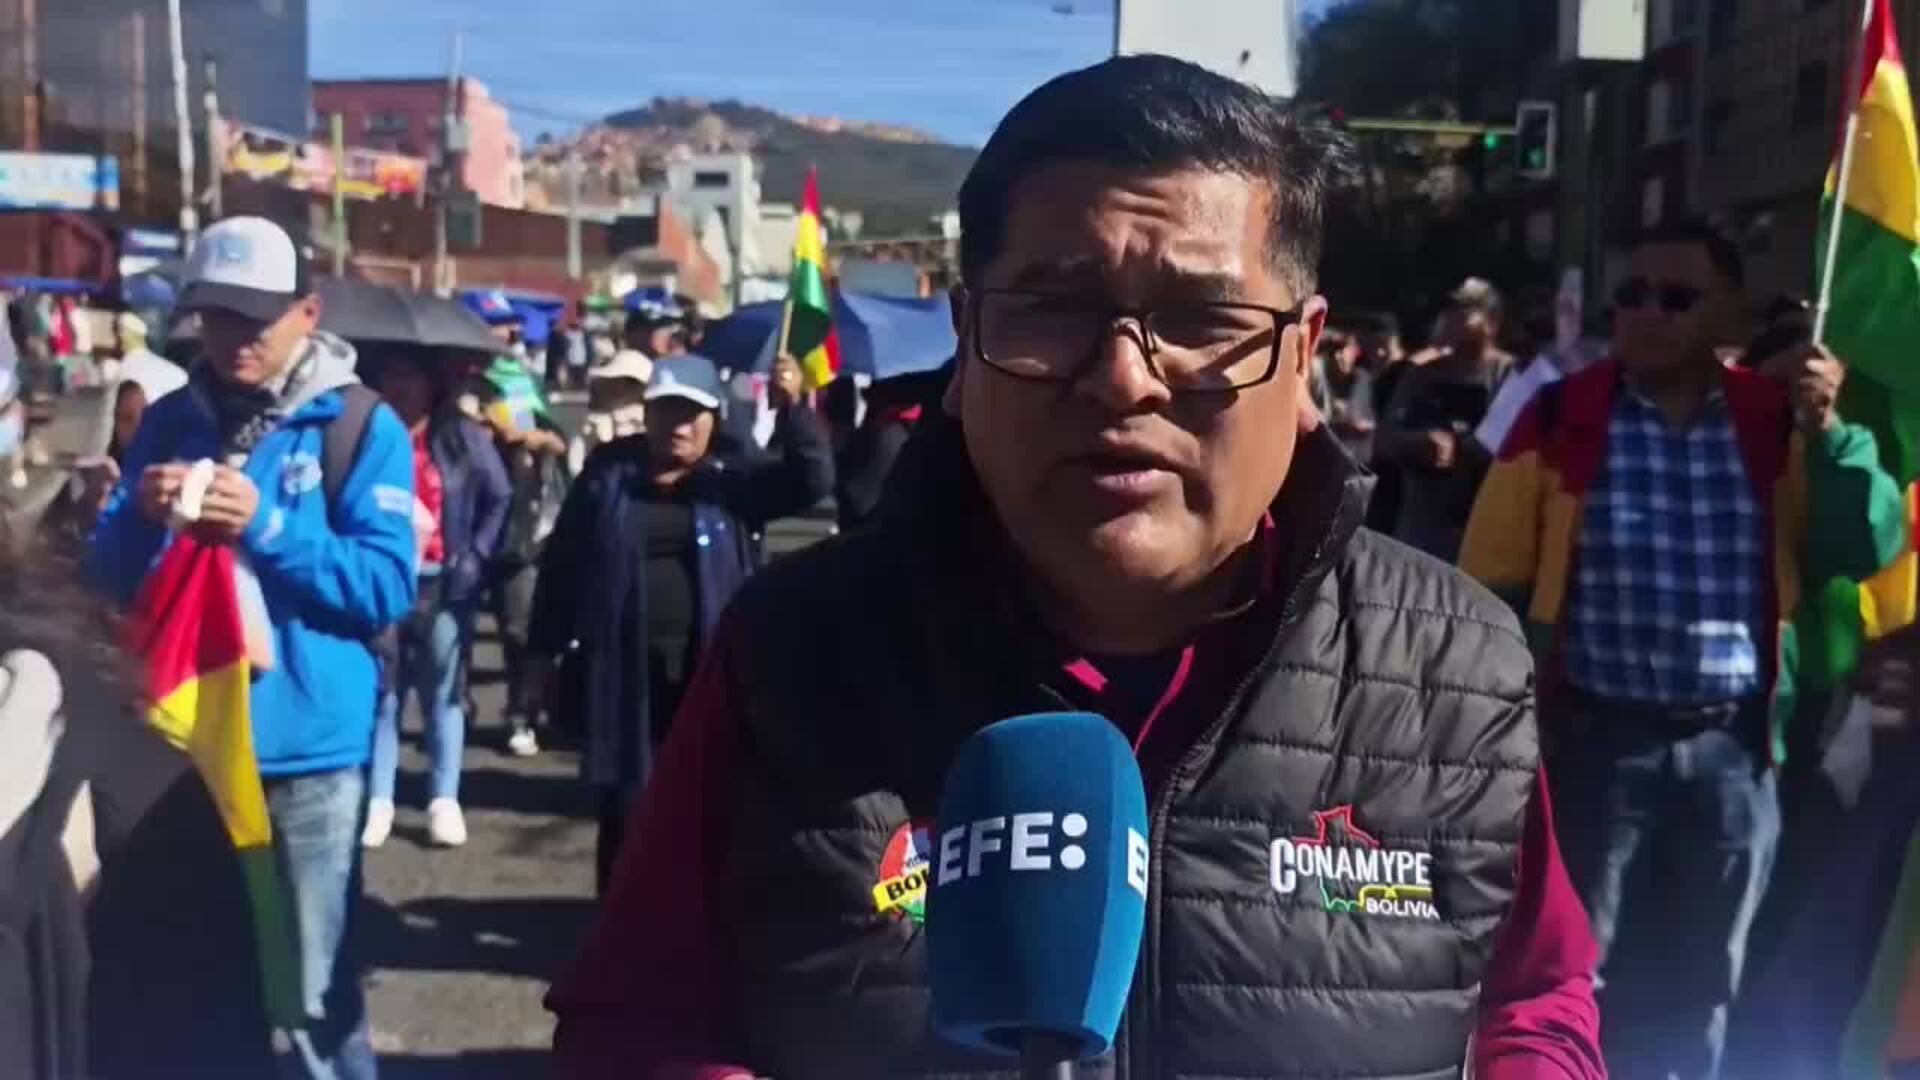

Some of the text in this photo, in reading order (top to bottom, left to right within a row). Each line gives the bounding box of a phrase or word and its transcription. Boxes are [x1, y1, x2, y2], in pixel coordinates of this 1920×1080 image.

[938, 812, 1088, 886] EFE:
[1270, 837, 1433, 893] CONAMYPE
[1366, 897, 1440, 920] BOLIVIA
